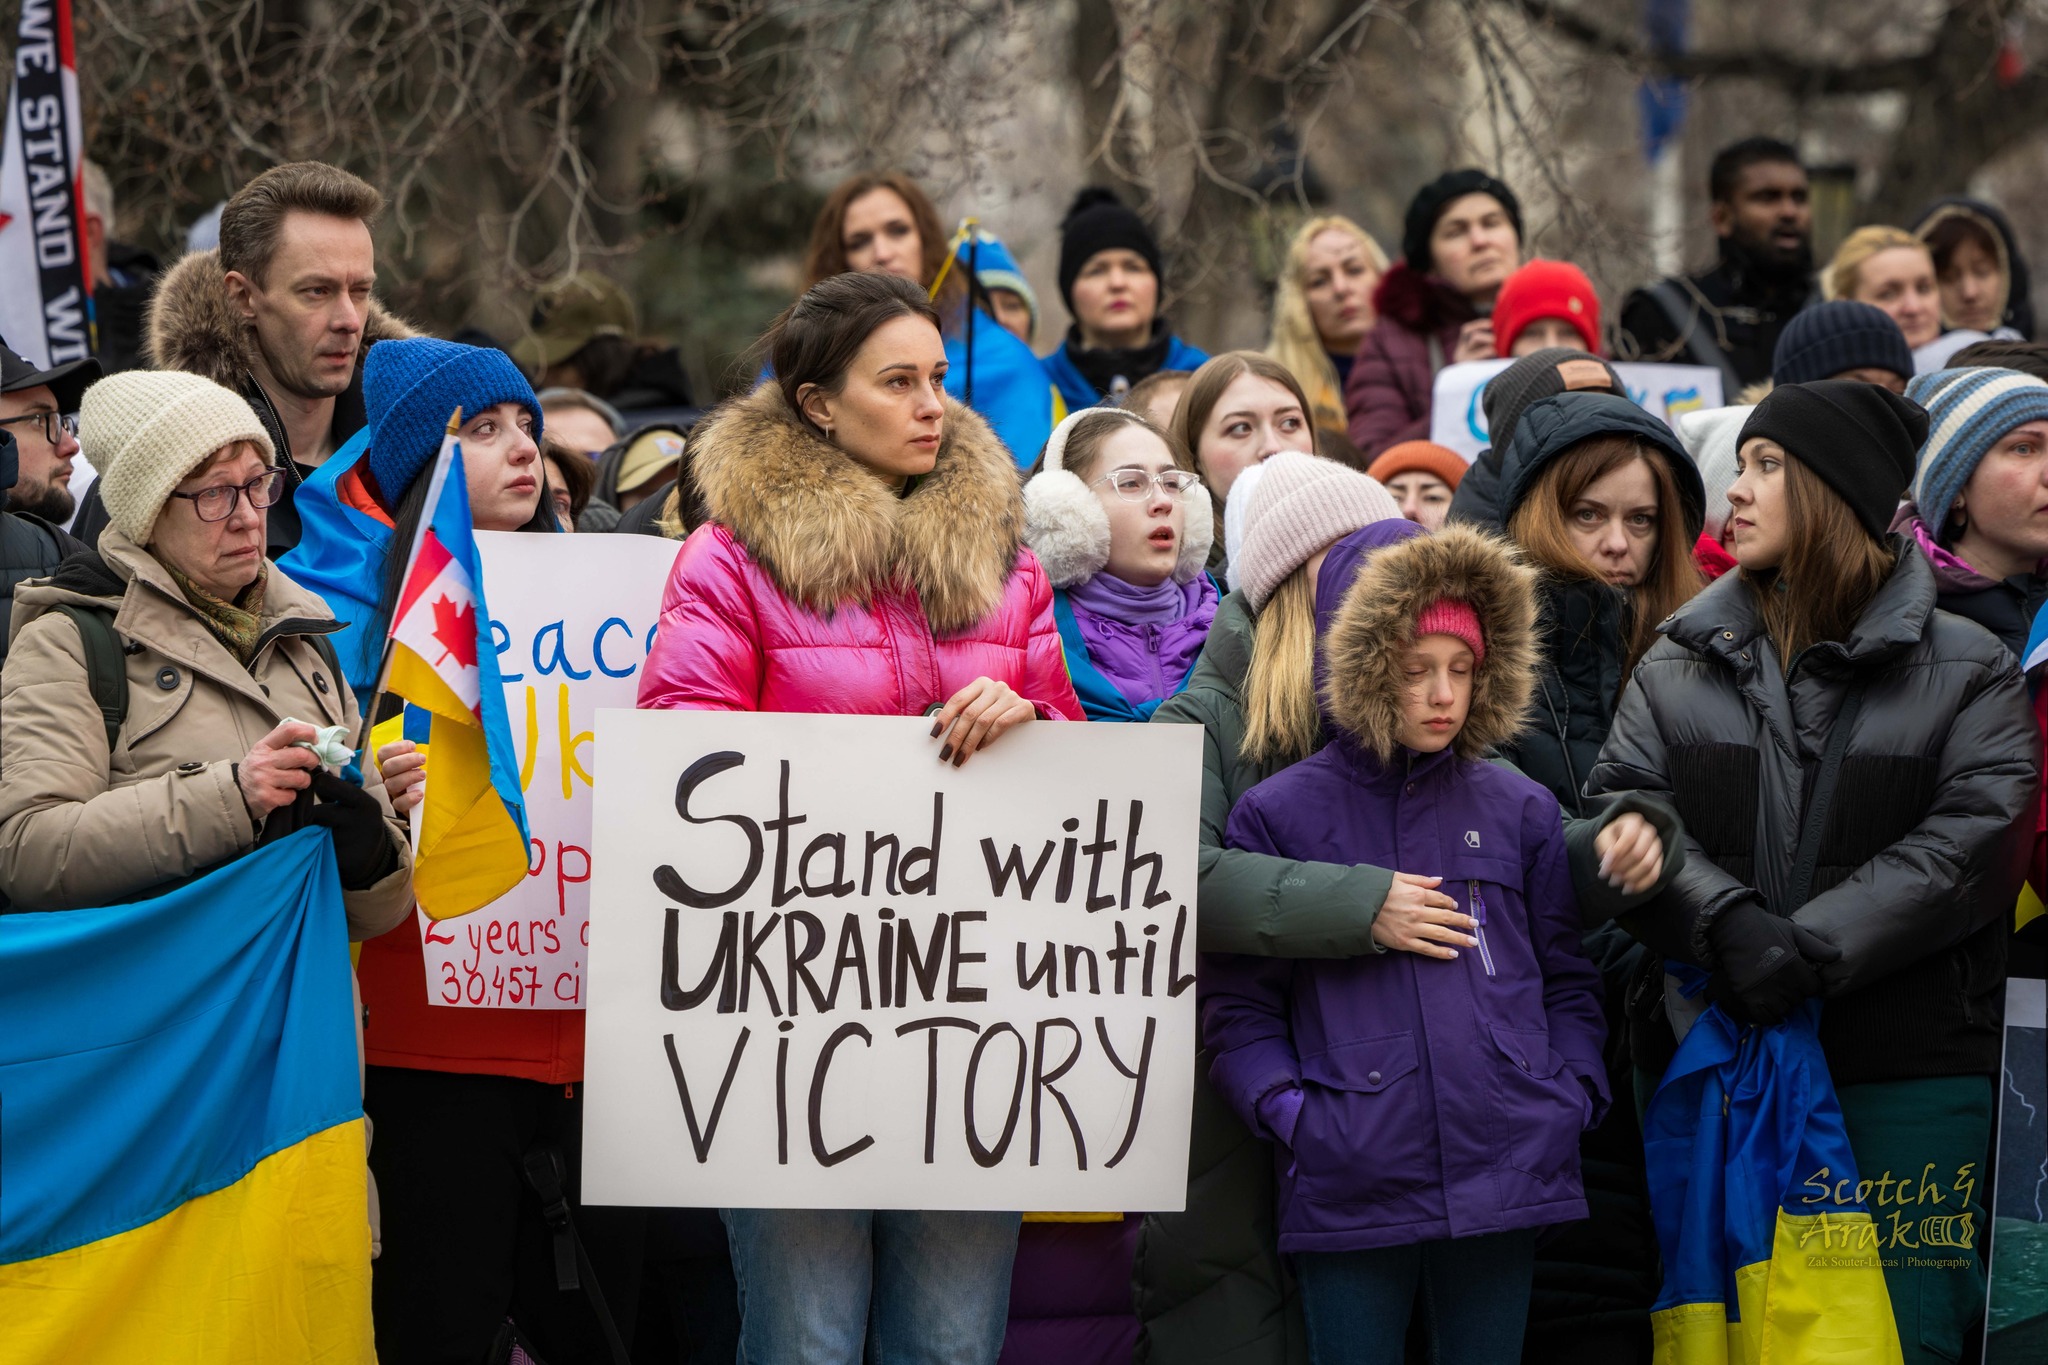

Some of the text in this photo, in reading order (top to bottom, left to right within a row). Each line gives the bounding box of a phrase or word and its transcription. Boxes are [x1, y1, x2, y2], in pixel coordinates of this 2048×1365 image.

[16, 0, 57, 78] WE
[20, 94, 75, 269] STAND
[489, 616, 659, 683] eac
[1808, 789, 1831, 843] CANADA
[1824, 730, 1848, 779] CANADA
[653, 750, 1172, 913] Stand with
[441, 961, 543, 1007] 30,457
[462, 918, 561, 975] years
[1016, 904, 1197, 998] until
